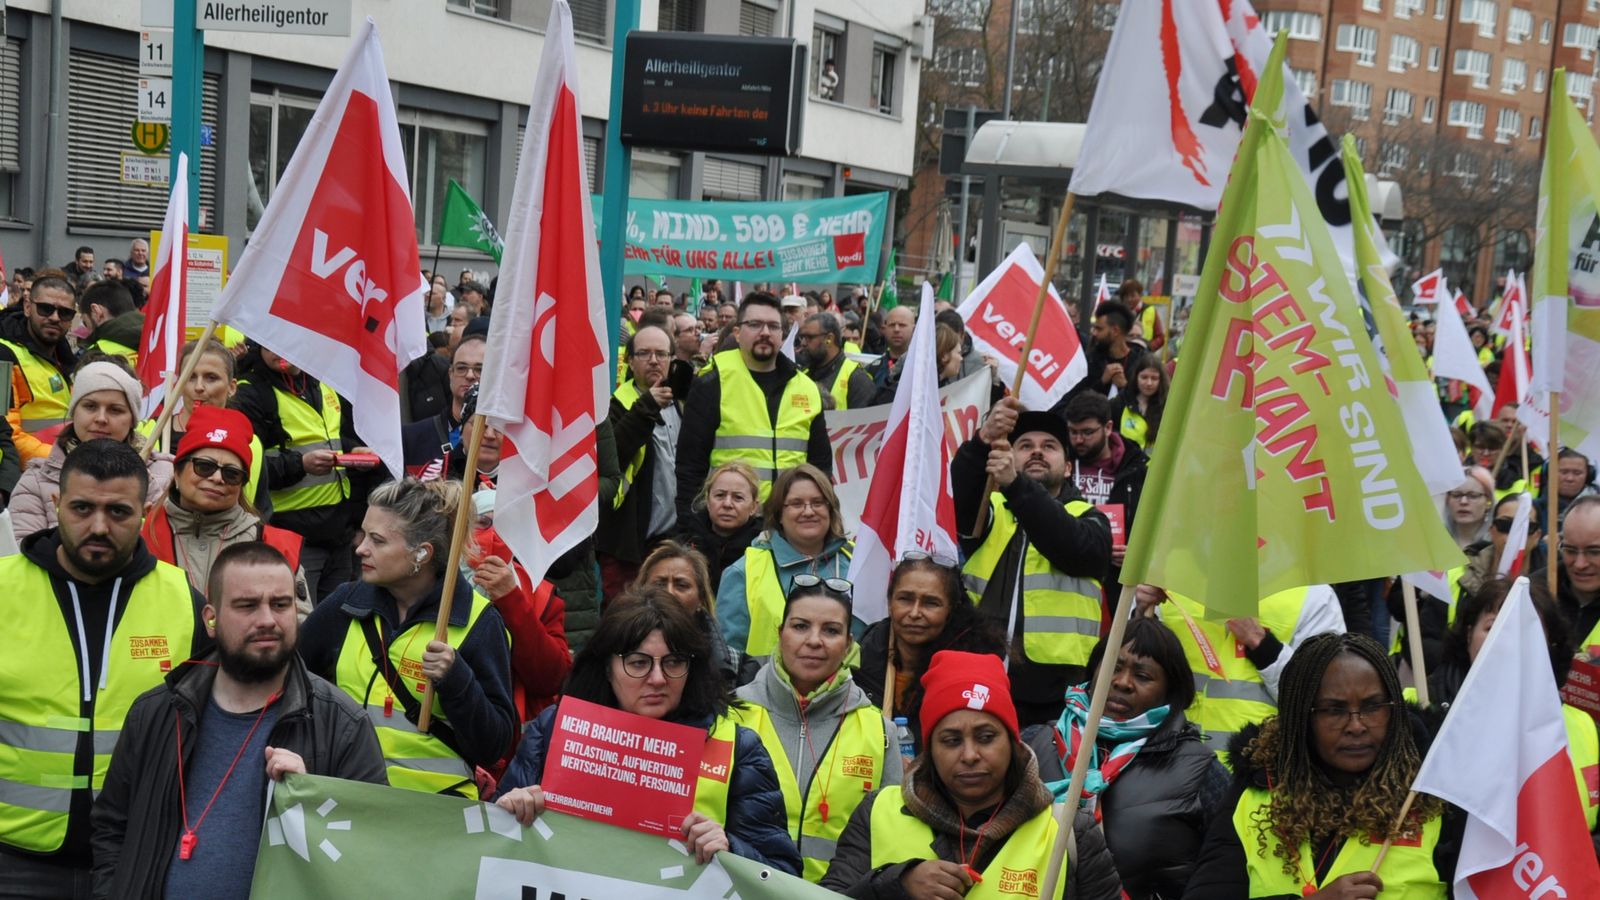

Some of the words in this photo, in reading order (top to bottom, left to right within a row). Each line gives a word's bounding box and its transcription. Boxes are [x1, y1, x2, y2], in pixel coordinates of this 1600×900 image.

[203, 2, 329, 27] Allerheiligentor
[147, 43, 164, 61] 11
[645, 59, 742, 78] Allerheiligentor
[147, 91, 166, 109] 14
[681, 103, 708, 116] keine
[710, 104, 750, 119] Fahrten
[652, 209, 727, 241] MIND.
[732, 213, 785, 242] 500
[651, 244, 682, 267] FÜR
[686, 249, 718, 269] UNS
[1097, 244, 1124, 257] KFC
[1574, 252, 1599, 273] für
[1307, 276, 1370, 392] WIR
[1339, 401, 1405, 531] SIND
[129, 639, 168, 648] ZUSAMMEN
[130, 648, 149, 657] GEHT
[962, 690, 990, 703] GEW
[561, 715, 590, 739] MEHR
[591, 725, 642, 750] BRAUCHT
[643, 736, 677, 758] MEHR
[564, 739, 619, 766] ENTLASTUNG,
[621, 754, 684, 780] AUFWERTUNG
[842, 757, 873, 768] ZUSAMMEN
[561, 754, 637, 787] WERTSCHÄTZUNG,
[639, 774, 691, 798] PERSONAL!
[999, 880, 1020, 891] GEHT
